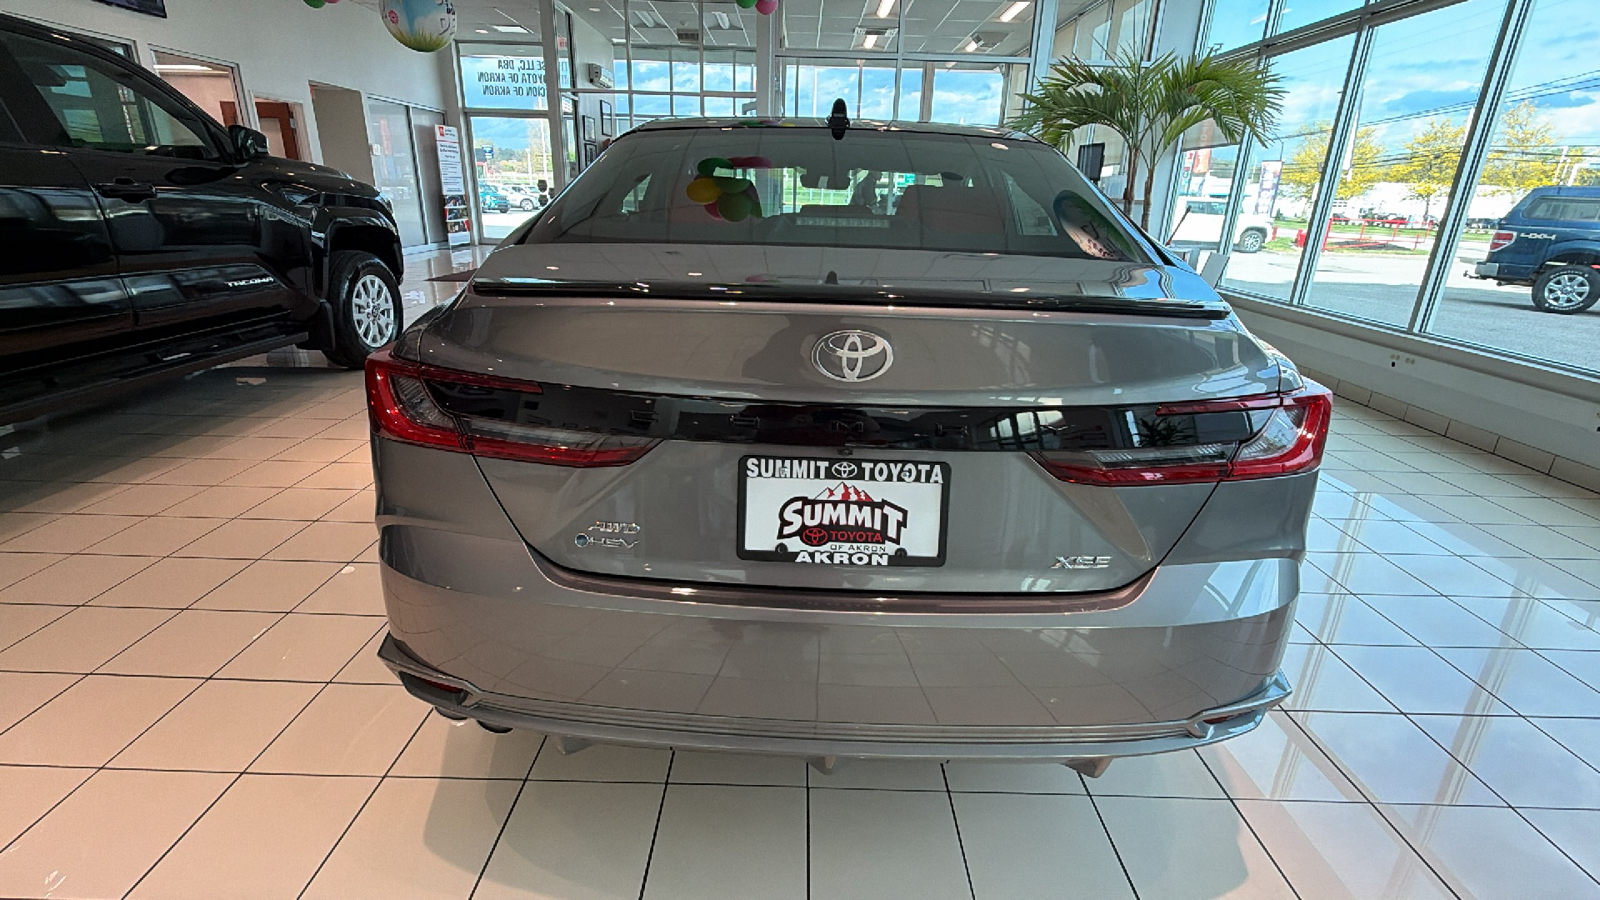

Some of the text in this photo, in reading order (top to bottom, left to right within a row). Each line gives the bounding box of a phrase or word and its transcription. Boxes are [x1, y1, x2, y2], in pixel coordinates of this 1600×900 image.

[746, 457, 943, 484] SUMMIT TOYOTA
[781, 500, 904, 541] SUMMIT
[829, 530, 883, 543] TOYOTA
[830, 543, 886, 553] OF AKRON
[794, 550, 889, 566] AKRON
[1050, 556, 1112, 569] XSE
